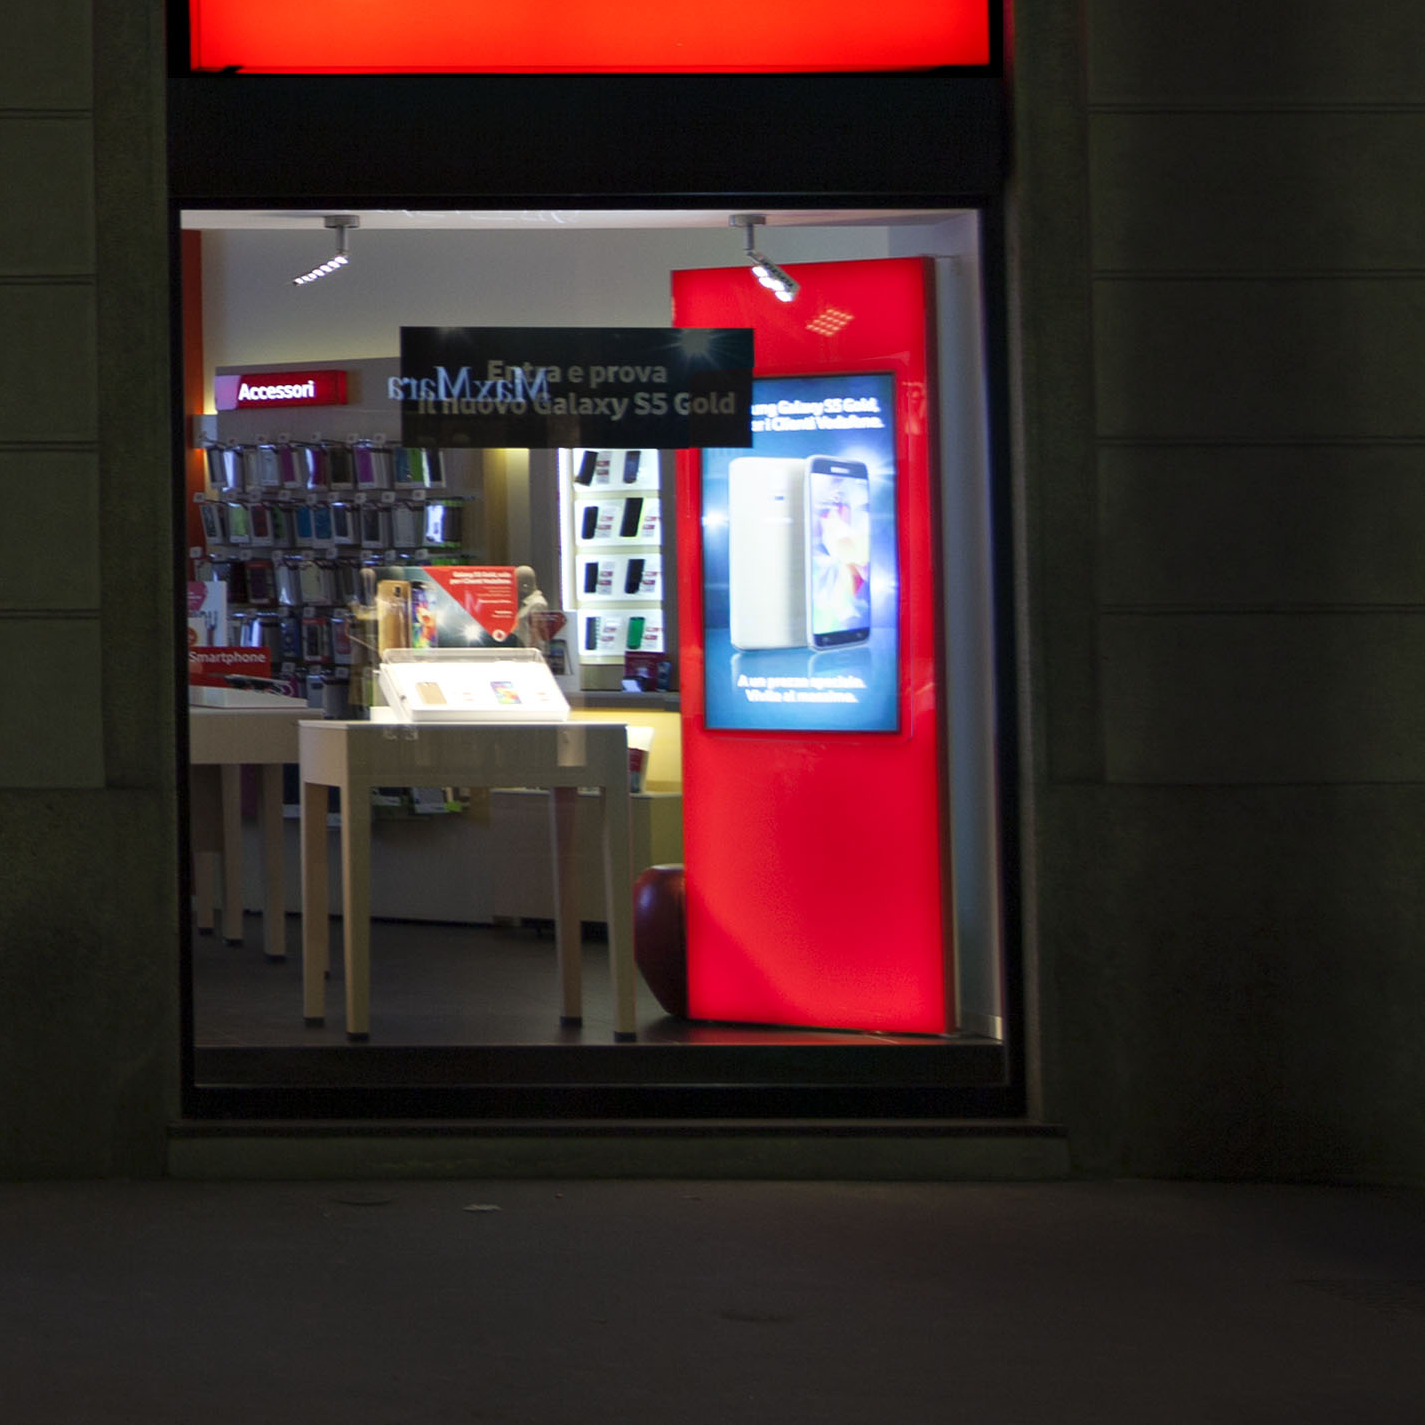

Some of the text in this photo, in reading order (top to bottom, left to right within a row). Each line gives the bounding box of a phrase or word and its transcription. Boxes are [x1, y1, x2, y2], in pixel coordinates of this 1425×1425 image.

[487, 360, 668, 388] Entra e prova
[238, 380, 315, 401] Accessori
[535, 391, 629, 421] Galaxy
[634, 391, 669, 416] S5
[674, 391, 736, 415] Gold
[188, 651, 267, 666] Smartphone
